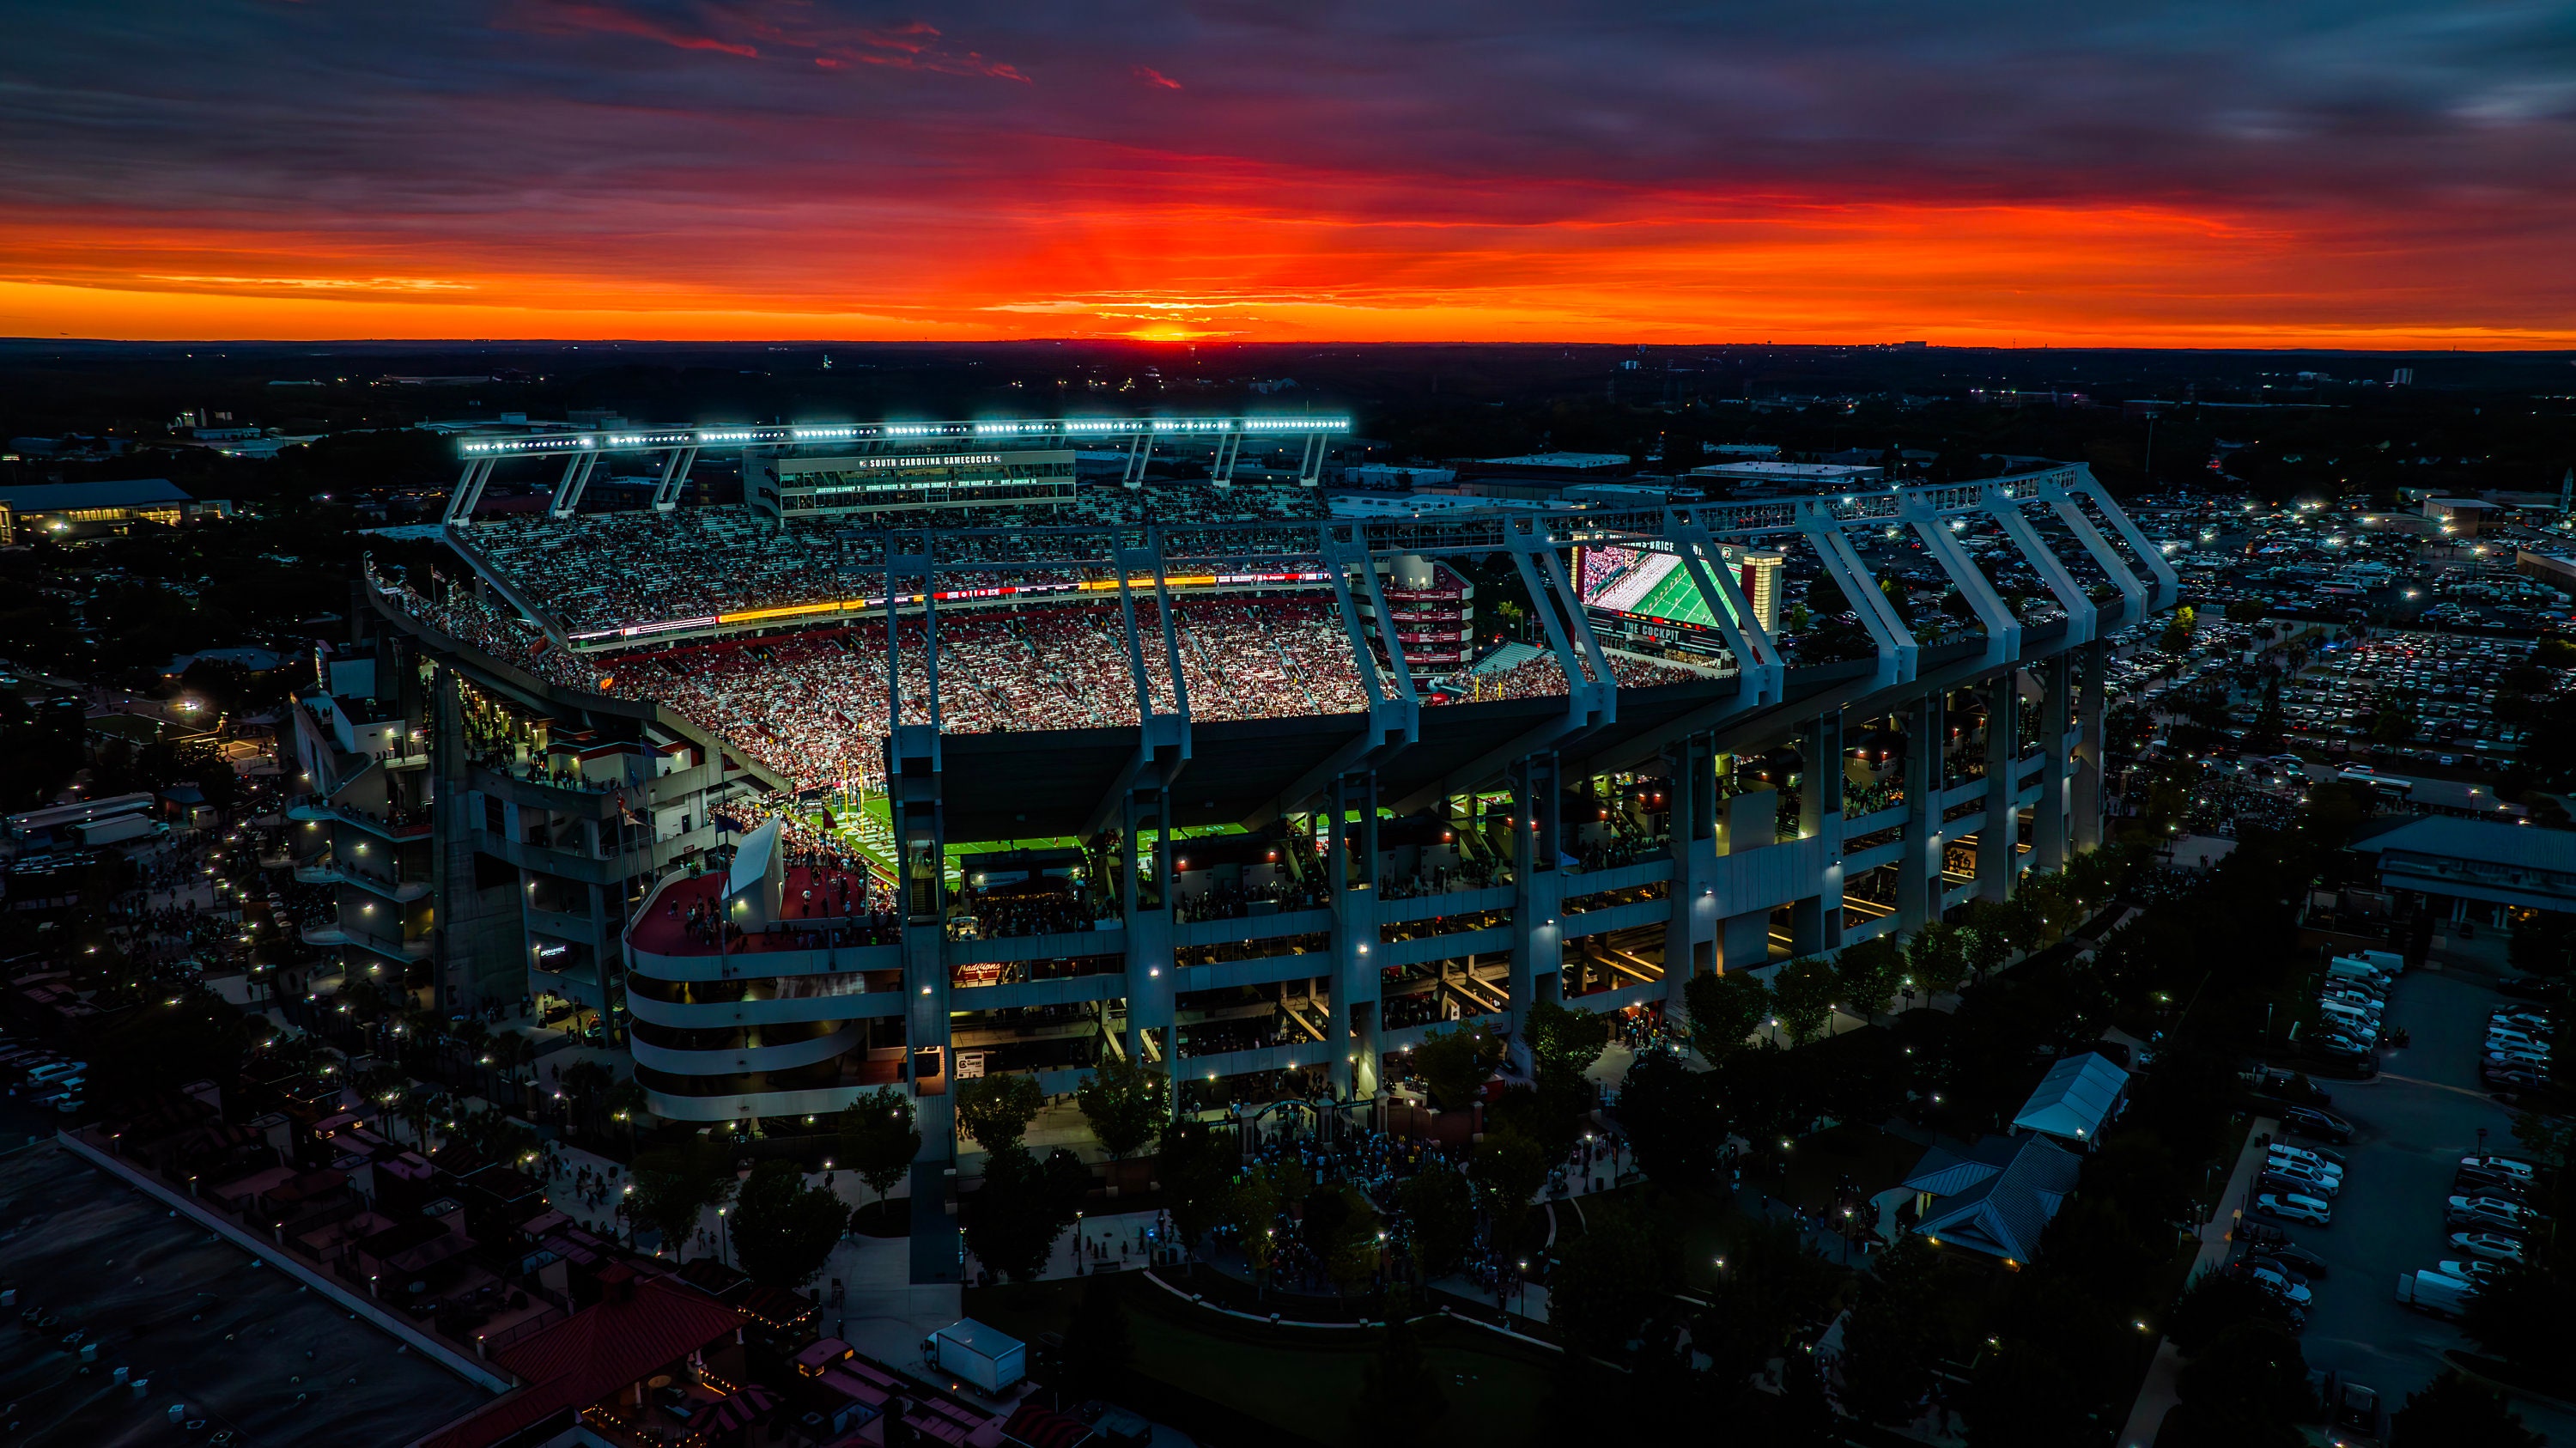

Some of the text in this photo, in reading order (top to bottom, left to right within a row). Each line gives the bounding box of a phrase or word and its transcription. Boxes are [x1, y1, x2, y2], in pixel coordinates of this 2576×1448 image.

[870, 455, 992, 467] SOUTH CAROLINA GAMECOCKS
[1623, 621, 1680, 641] THE COCKPIT
